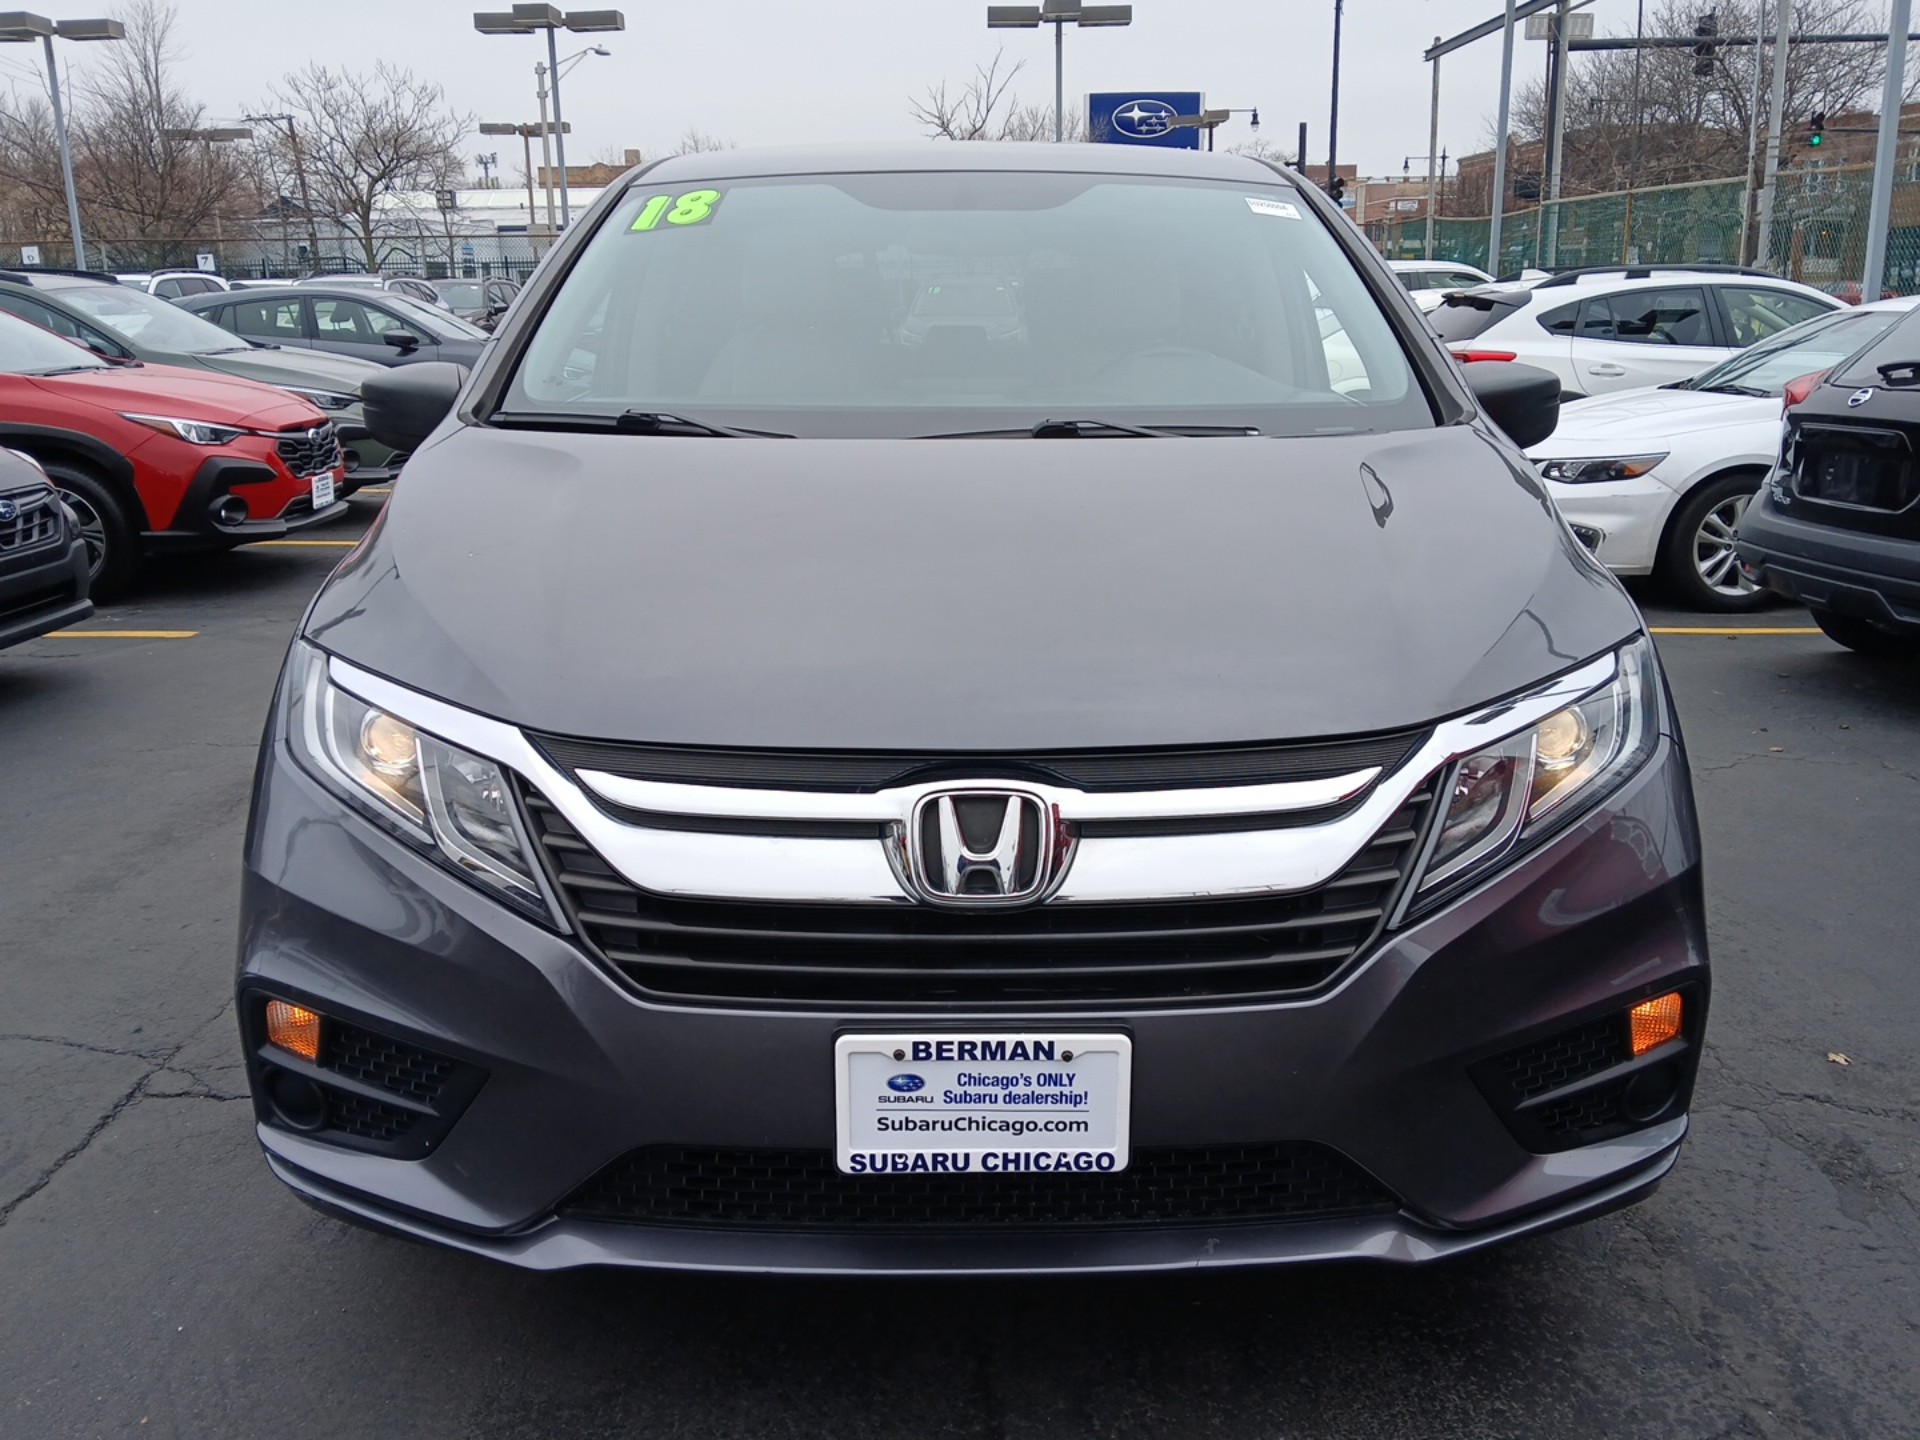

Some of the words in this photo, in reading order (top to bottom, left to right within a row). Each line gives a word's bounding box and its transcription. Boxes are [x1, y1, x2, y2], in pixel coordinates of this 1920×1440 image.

[630, 189, 721, 231] 18
[912, 1041, 1055, 1061] BERMAN
[957, 1073, 1032, 1089] Chicago's
[1036, 1073, 1076, 1087] ONLY
[878, 1095, 934, 1103] SUBARU
[943, 1090, 998, 1105] Subaru
[1002, 1090, 1088, 1107] dealership!
[876, 1117, 1089, 1135] SubaruChicago.com
[850, 1153, 970, 1172] SUBARU
[981, 1152, 1115, 1171] CHICAGO
